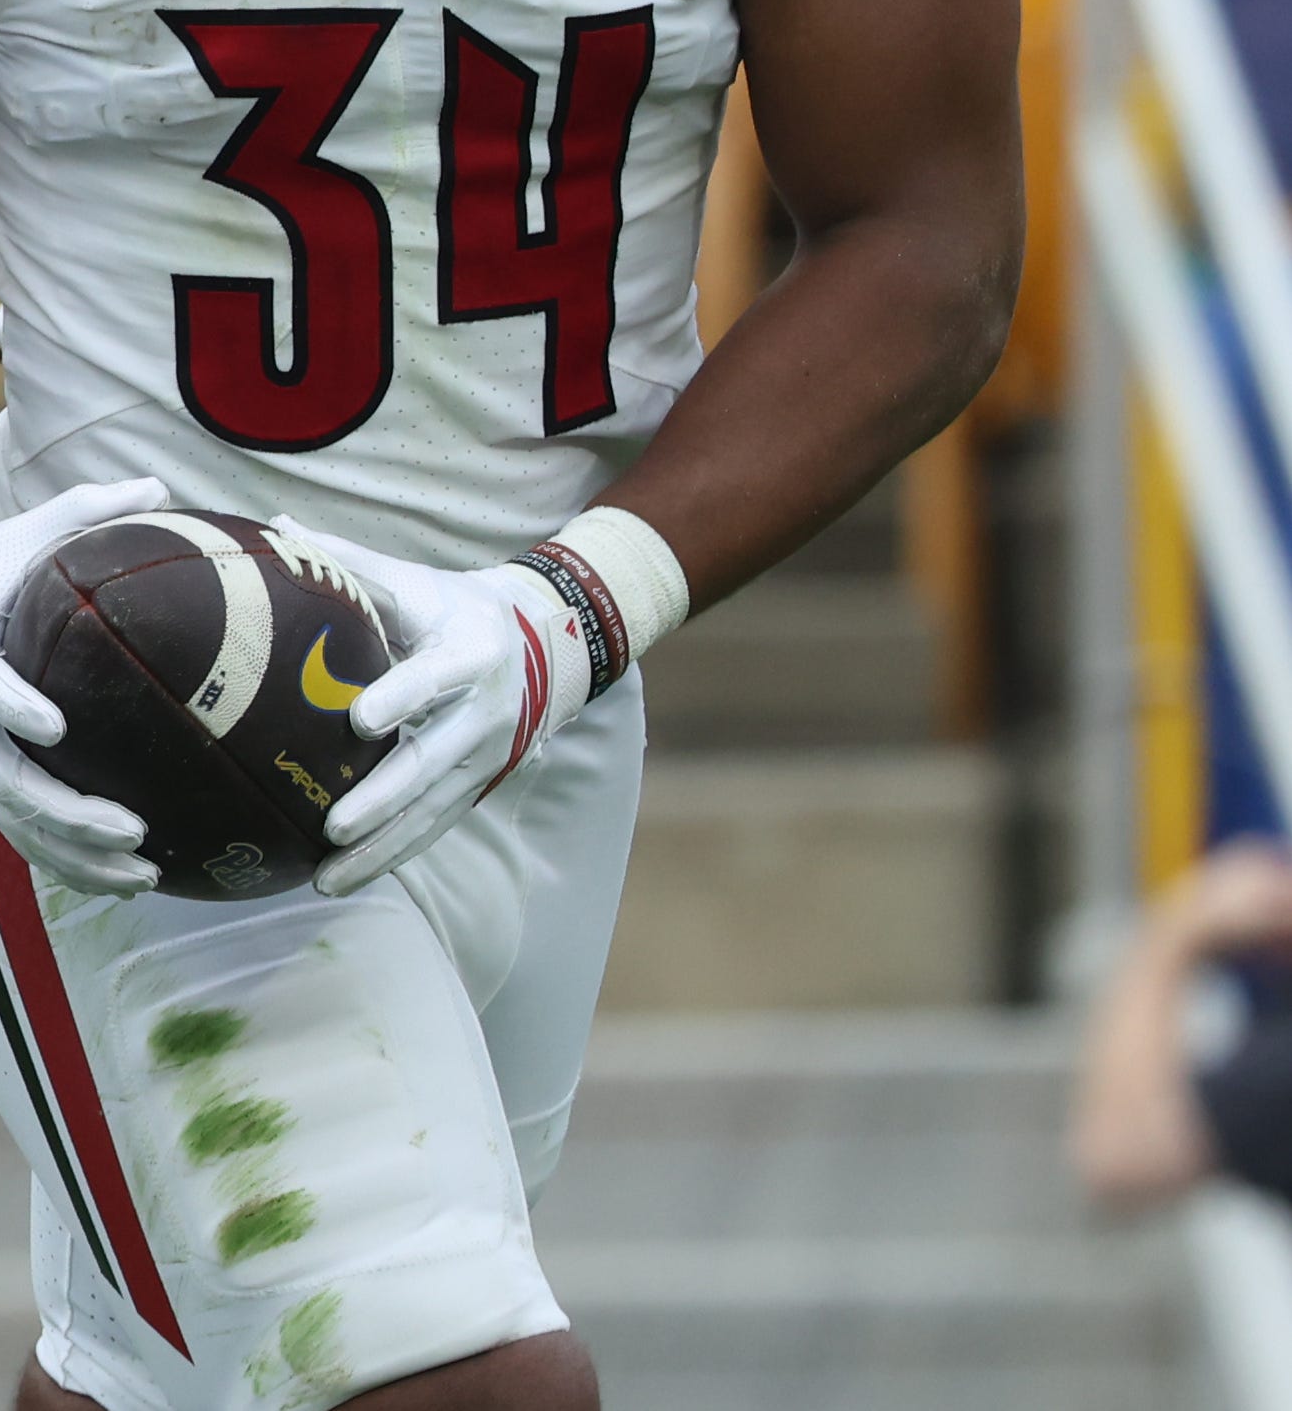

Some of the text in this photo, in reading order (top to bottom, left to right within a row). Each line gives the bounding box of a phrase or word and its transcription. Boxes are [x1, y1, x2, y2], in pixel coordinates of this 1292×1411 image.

[154, 3, 655, 454] 34
[592, 587, 615, 618] fear?
[274, 749, 332, 811] VAPOR
